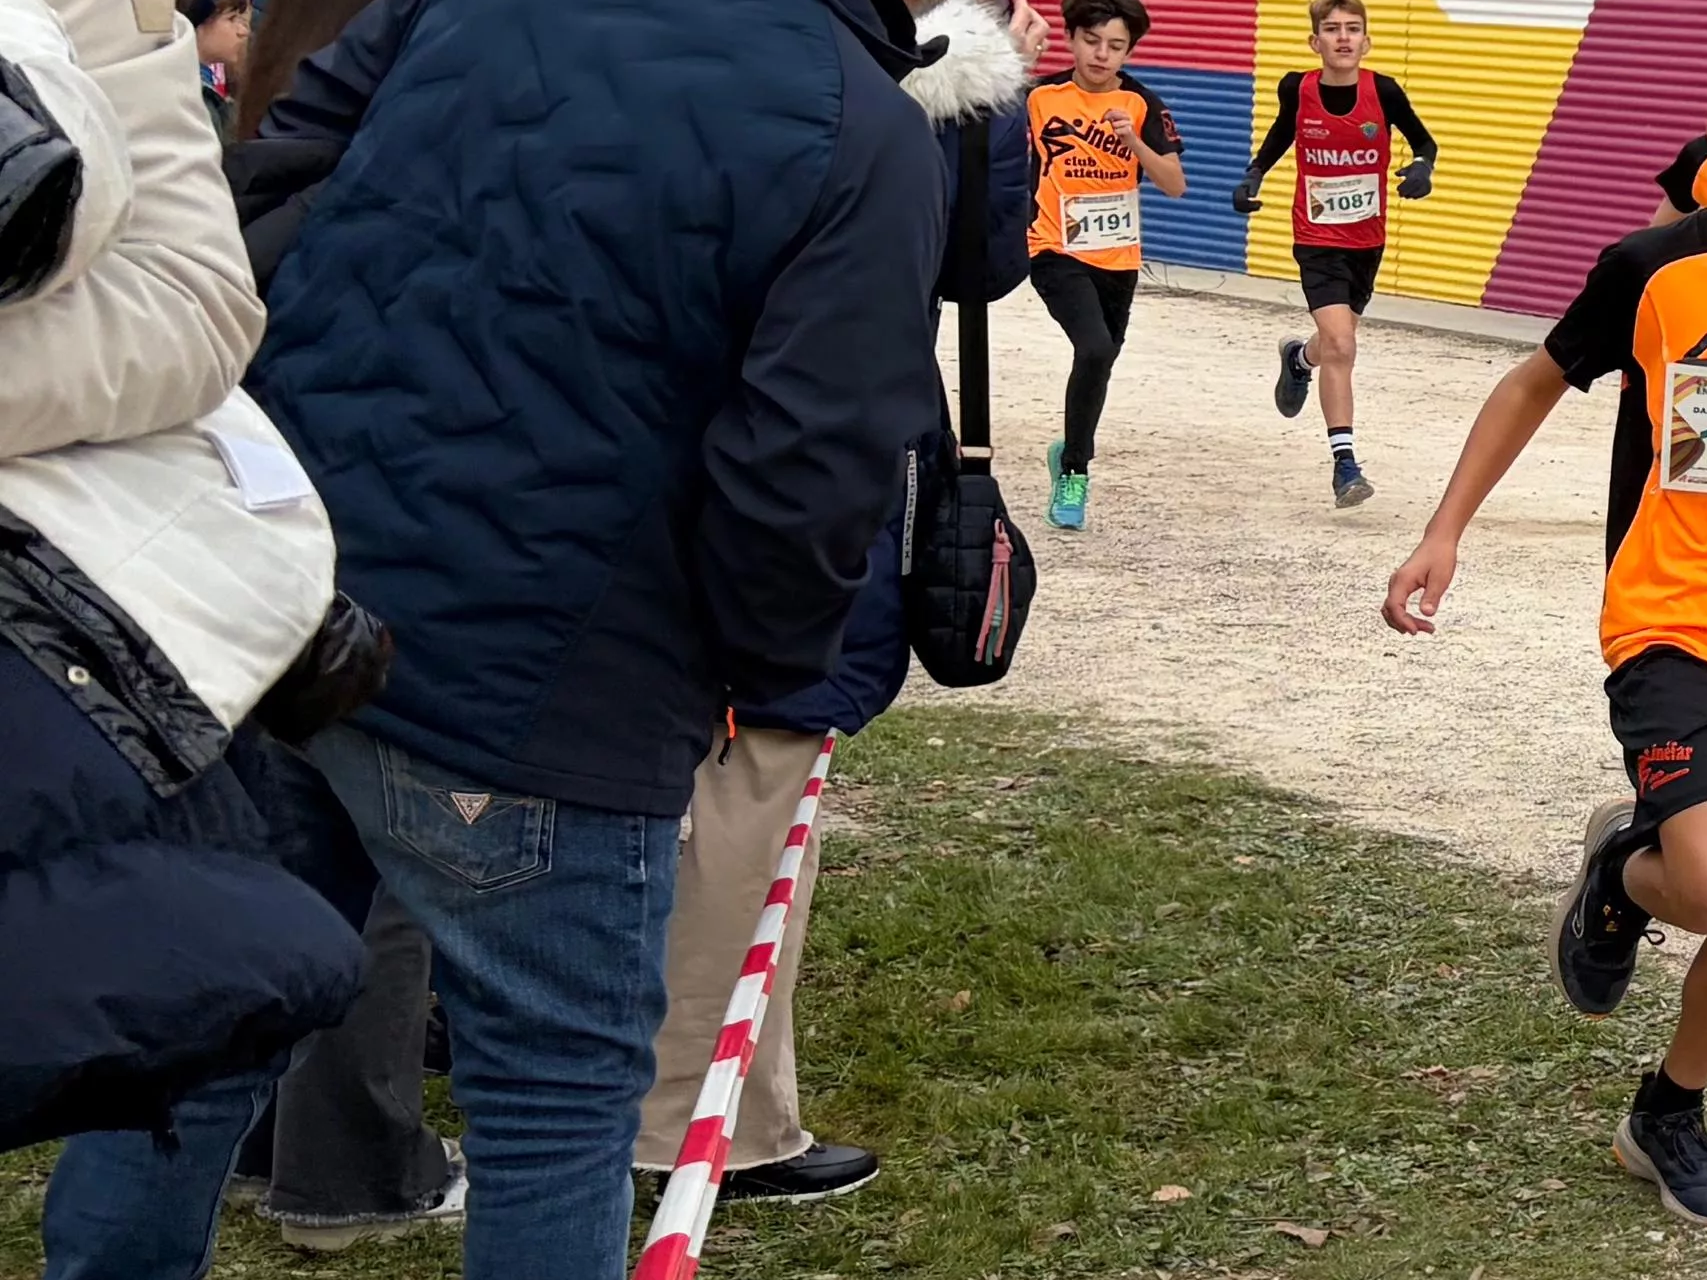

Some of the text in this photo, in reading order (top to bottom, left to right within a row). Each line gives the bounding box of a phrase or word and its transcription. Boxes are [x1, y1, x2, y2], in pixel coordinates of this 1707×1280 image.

[1064, 156, 1097, 167] club
[1305, 147, 1379, 166] HINACO
[1324, 190, 1376, 211] 1087
[1079, 212, 1132, 233] 1191
